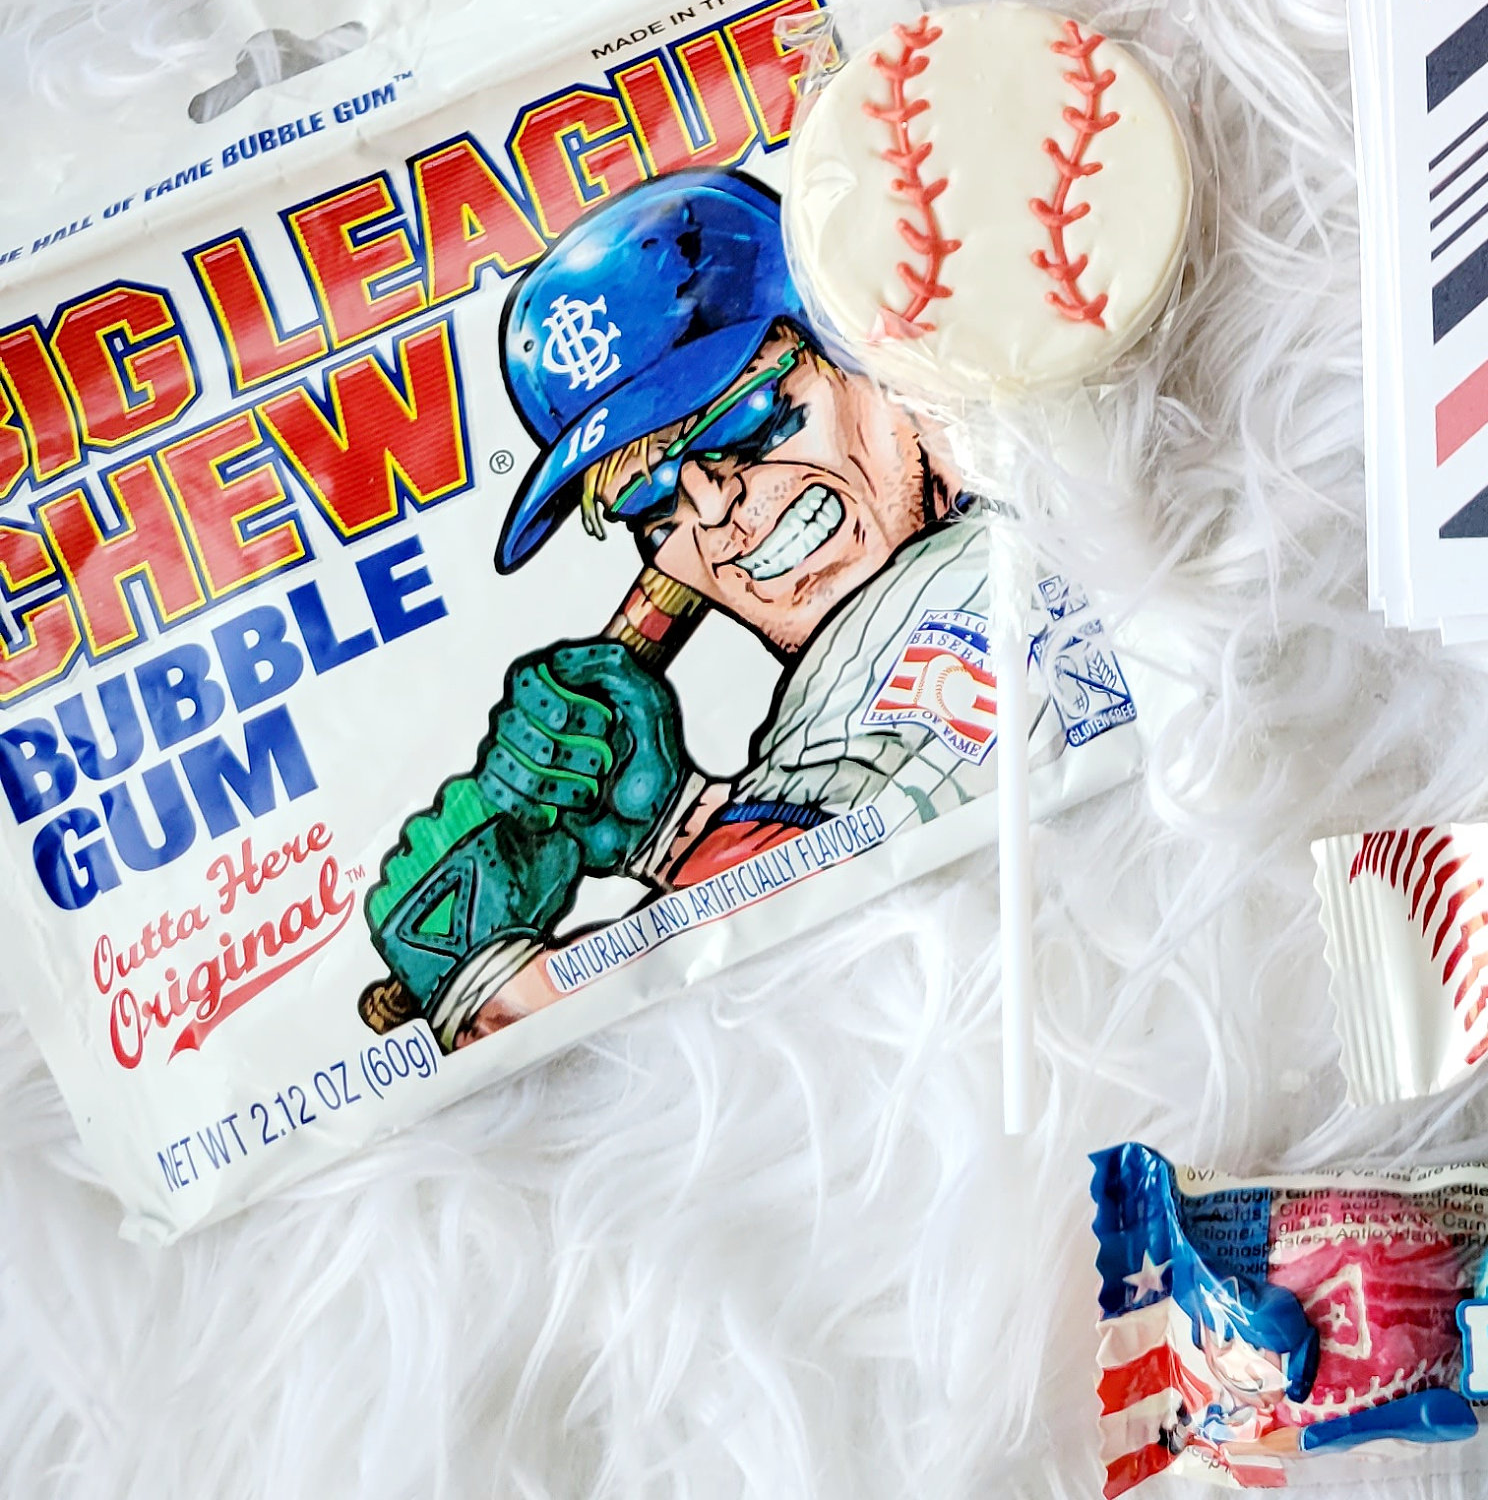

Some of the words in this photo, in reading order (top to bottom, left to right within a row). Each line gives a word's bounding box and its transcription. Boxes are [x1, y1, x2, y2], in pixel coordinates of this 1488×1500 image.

[590, 25, 644, 60] MADE
[670, 7, 696, 26] IN
[0, 245, 24, 266] HE
[31, 216, 94, 254] HALL
[103, 195, 137, 219] OF
[144, 158, 214, 202] FAME
[221, 110, 326, 168] BUBBLE
[0, 534, 450, 826] BUBBLE
[909, 631, 985, 671] BASEBA
[926, 612, 989, 634] NATIO
[31, 702, 319, 912] GUM
[869, 710, 917, 723] HALL
[921, 710, 942, 726] OF
[942, 725, 983, 758] FAME
[1069, 715, 1110, 747] GLUTEN
[93, 900, 210, 995] Outta
[206, 822, 334, 915] Here
[551, 913, 649, 992] NATURALLY
[653, 897, 691, 938] AND
[692, 841, 799, 920] ARTIFICIALLY
[799, 805, 887, 874] FLAVORED
[157, 1137, 201, 1193] NET
[200, 1114, 249, 1170] WT
[250, 1082, 319, 1145] 2.12
[314, 1062, 362, 1110] OZ
[360, 1025, 441, 1102] (60g)
